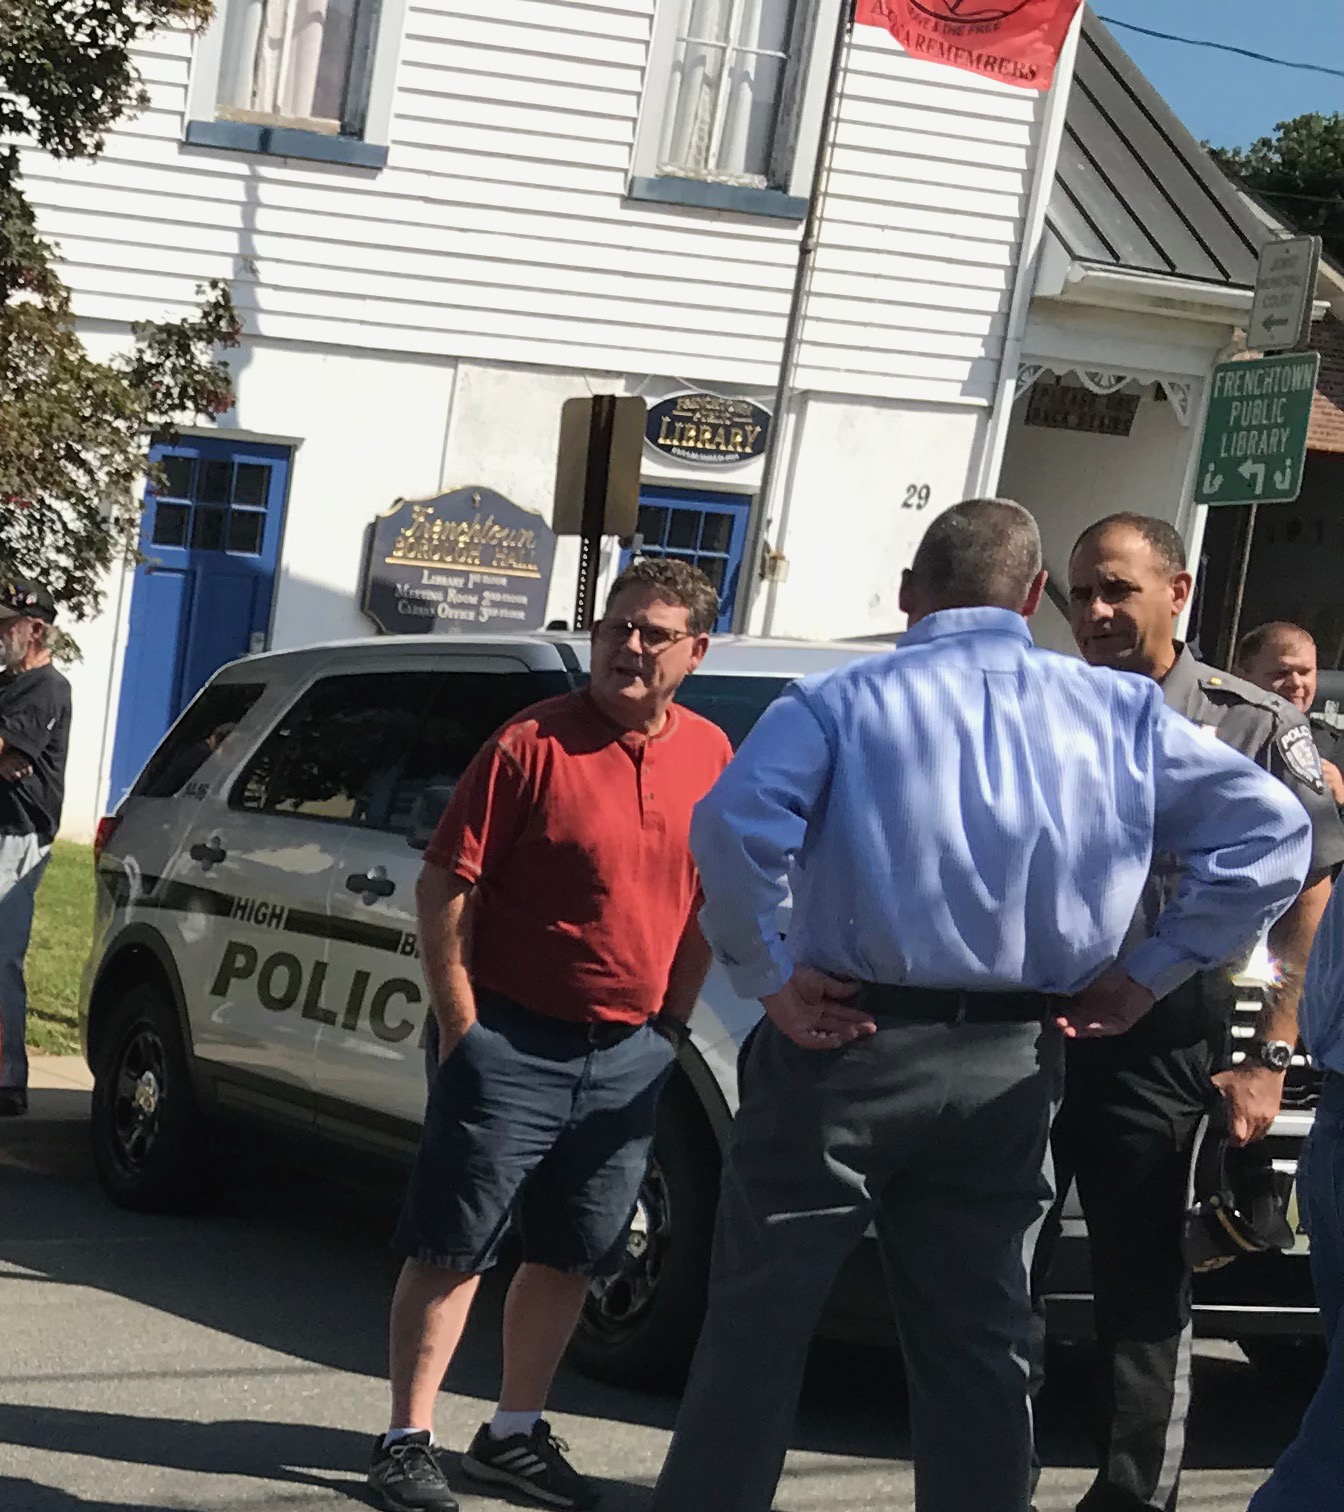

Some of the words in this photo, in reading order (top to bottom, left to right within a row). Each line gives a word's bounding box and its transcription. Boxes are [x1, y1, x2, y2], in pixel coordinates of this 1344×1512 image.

[1214, 363, 1313, 398] FRENCHTOWN
[1229, 397, 1287, 427] PUBLIC
[657, 415, 762, 453] LIBRARY
[1220, 428, 1290, 458] LIBRARY
[901, 483, 931, 511] 29
[232, 897, 285, 930] HIGH
[209, 940, 428, 1050] POLIC
